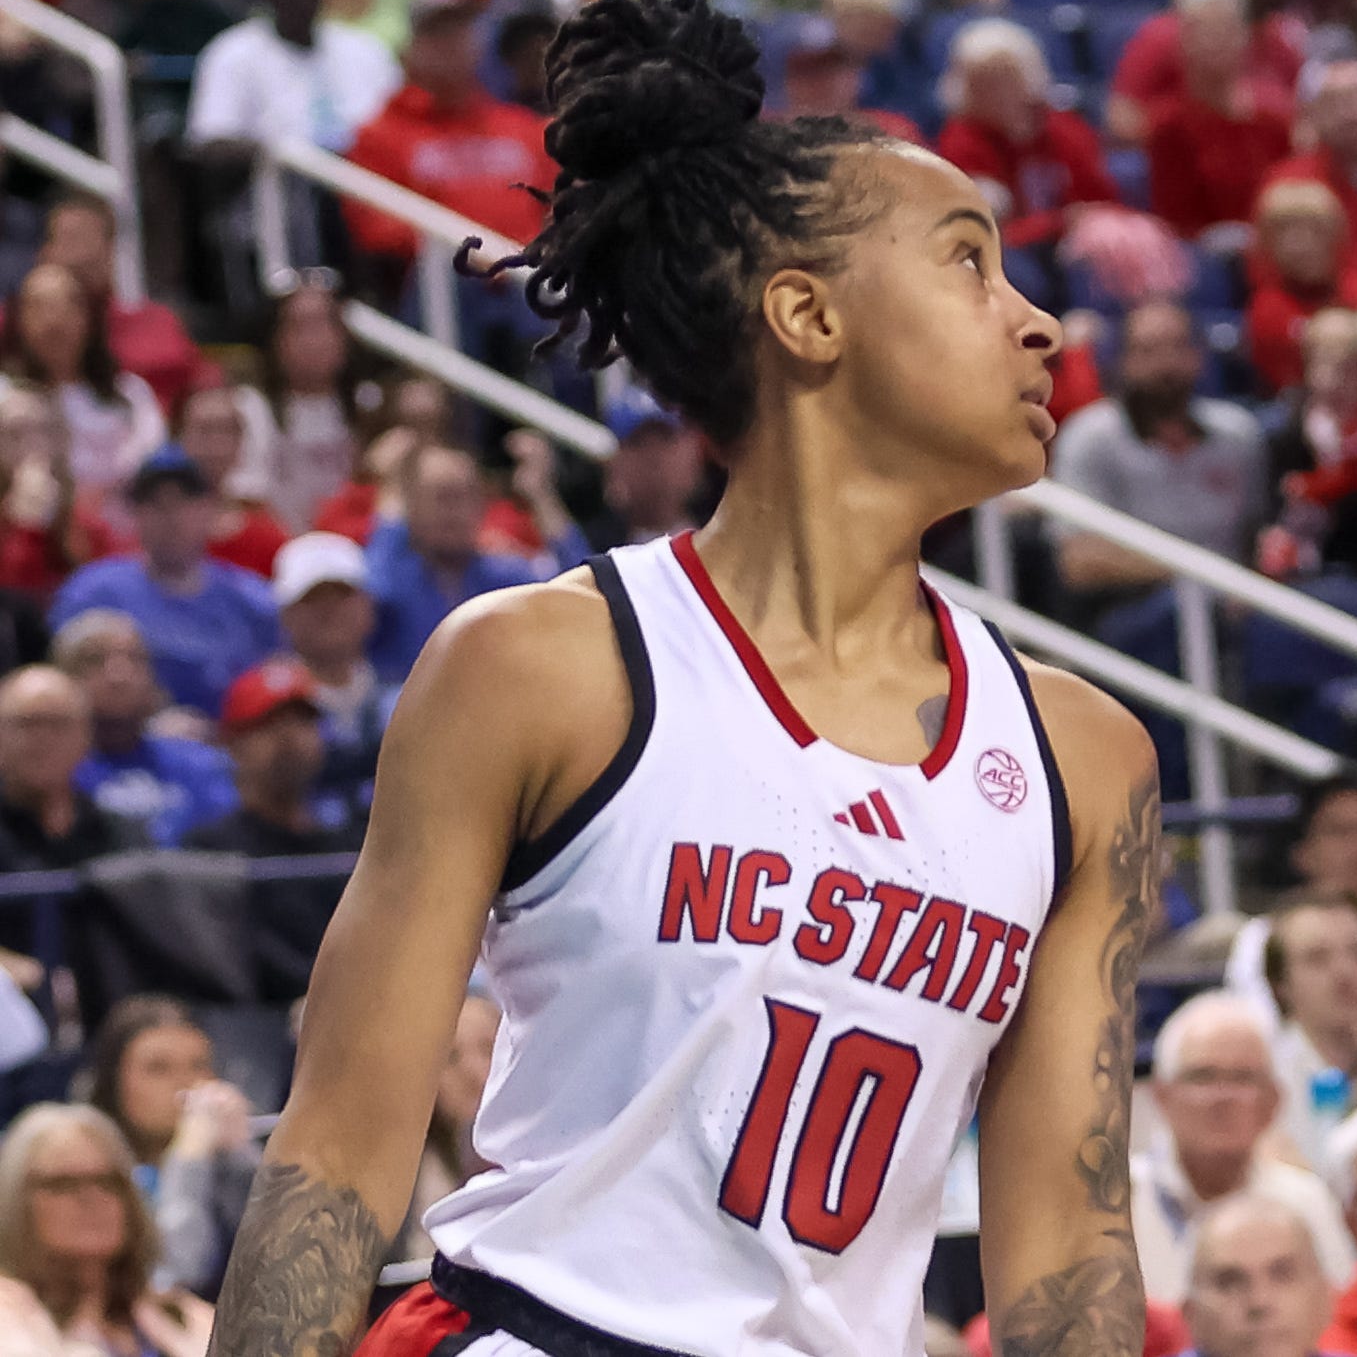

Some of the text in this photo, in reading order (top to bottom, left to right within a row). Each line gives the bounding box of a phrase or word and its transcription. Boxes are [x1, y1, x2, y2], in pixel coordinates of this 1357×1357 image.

[657, 841, 1032, 1025] NC STATE
[717, 994, 924, 1256] 10
